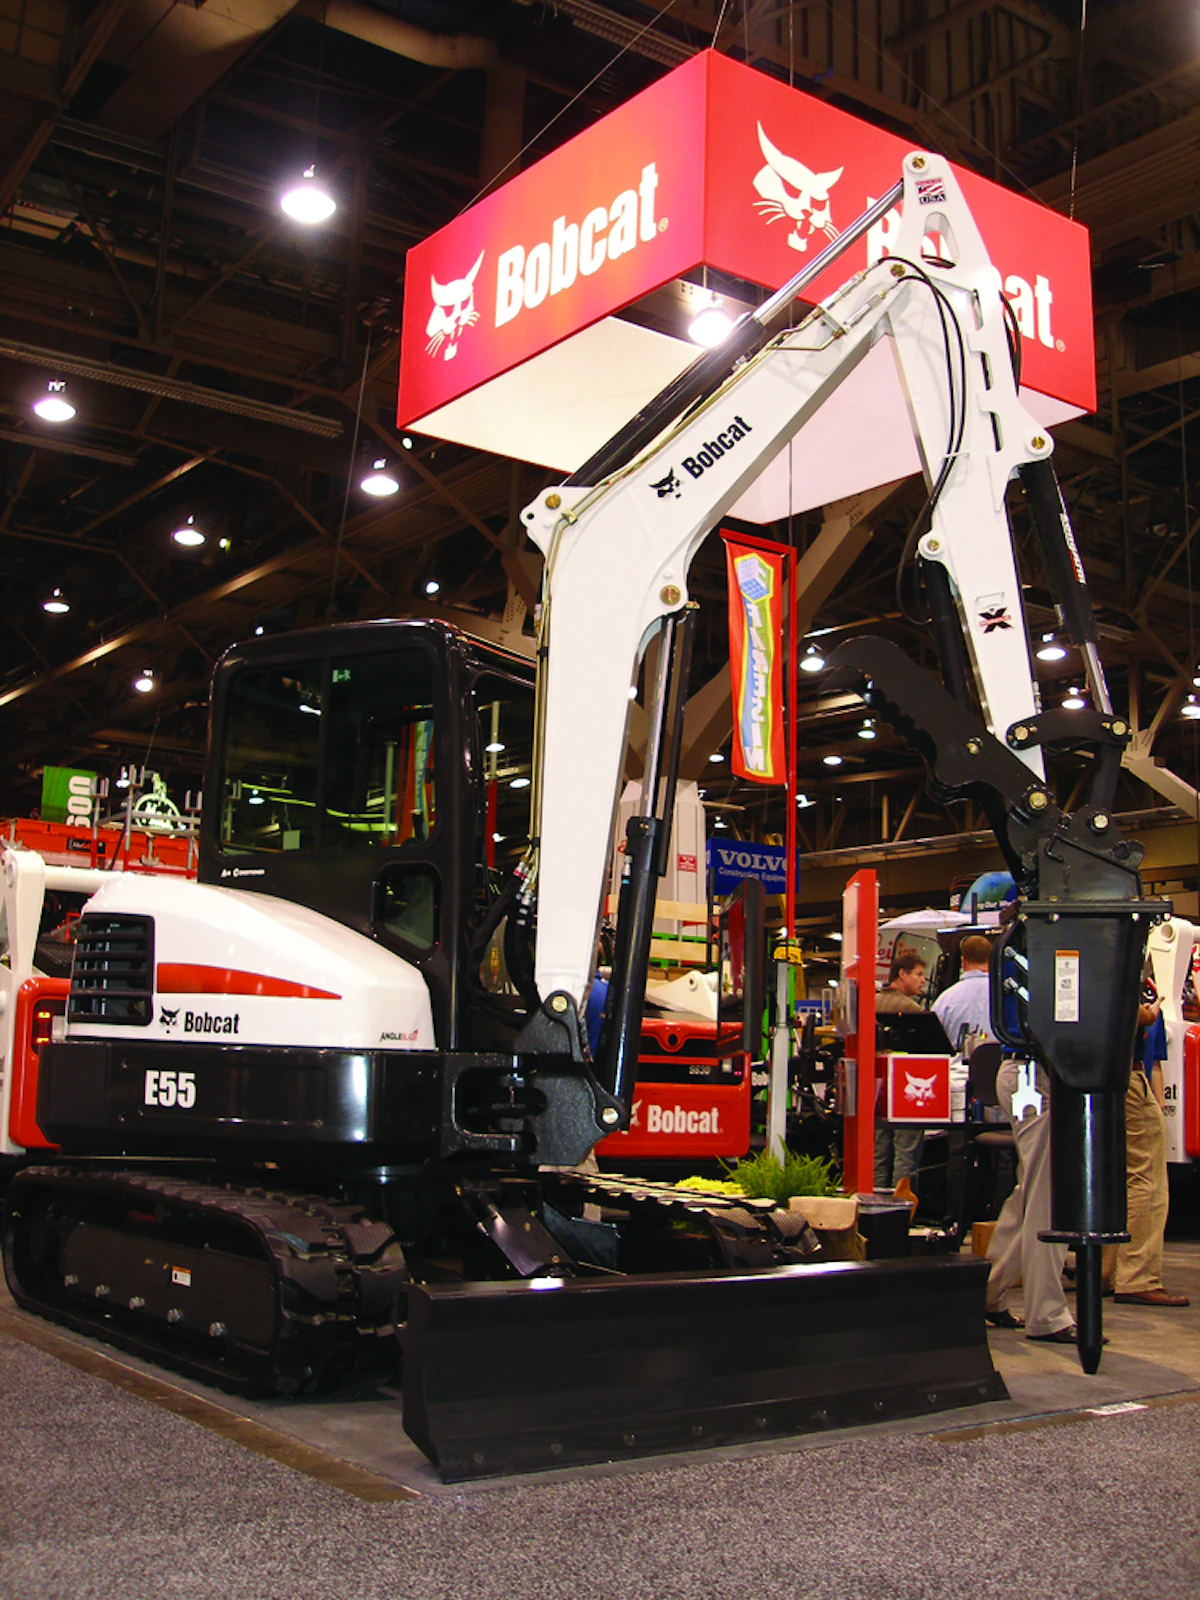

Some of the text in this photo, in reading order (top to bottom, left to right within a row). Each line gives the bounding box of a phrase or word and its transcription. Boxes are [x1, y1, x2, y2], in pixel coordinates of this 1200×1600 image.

[494, 161, 659, 329] Bobcat
[681, 415, 753, 479] Bobcat
[183, 1011, 240, 1034] Bobcat
[144, 1069, 197, 1109] E55
[647, 1104, 719, 1134] Bobcat
